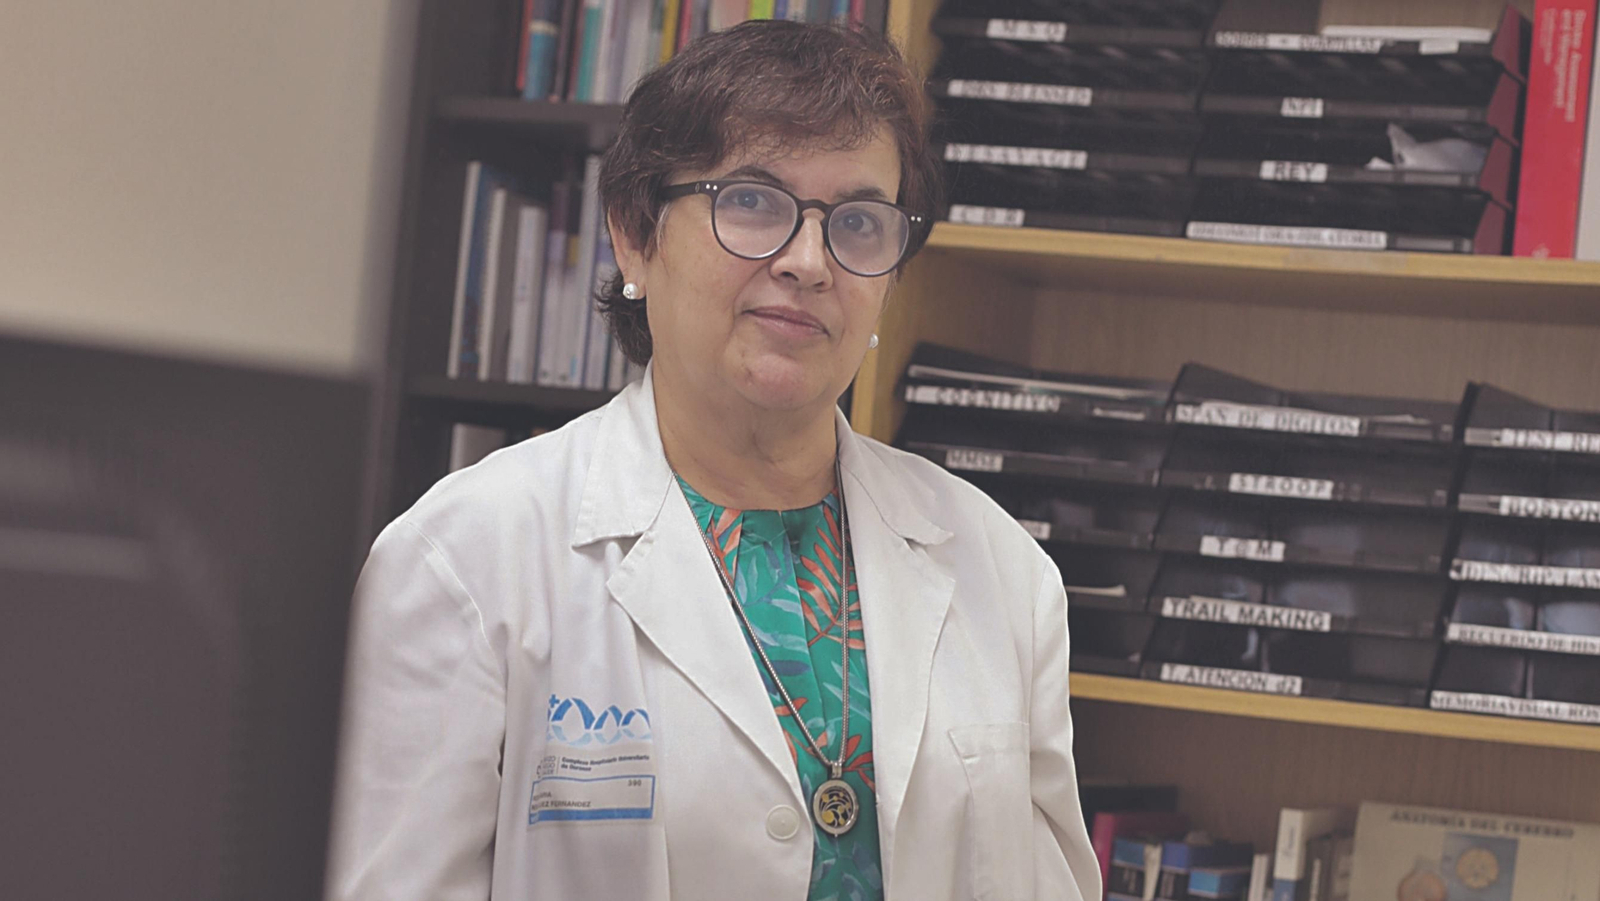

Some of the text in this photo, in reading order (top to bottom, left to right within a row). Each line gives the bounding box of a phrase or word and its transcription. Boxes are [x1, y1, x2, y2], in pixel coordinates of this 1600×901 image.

[1275, 162, 1316, 181] REY
[1240, 475, 1326, 498] STROOP
[1509, 497, 1600, 521] BOSTON
[1170, 600, 1325, 630] TRAIL MAKING
